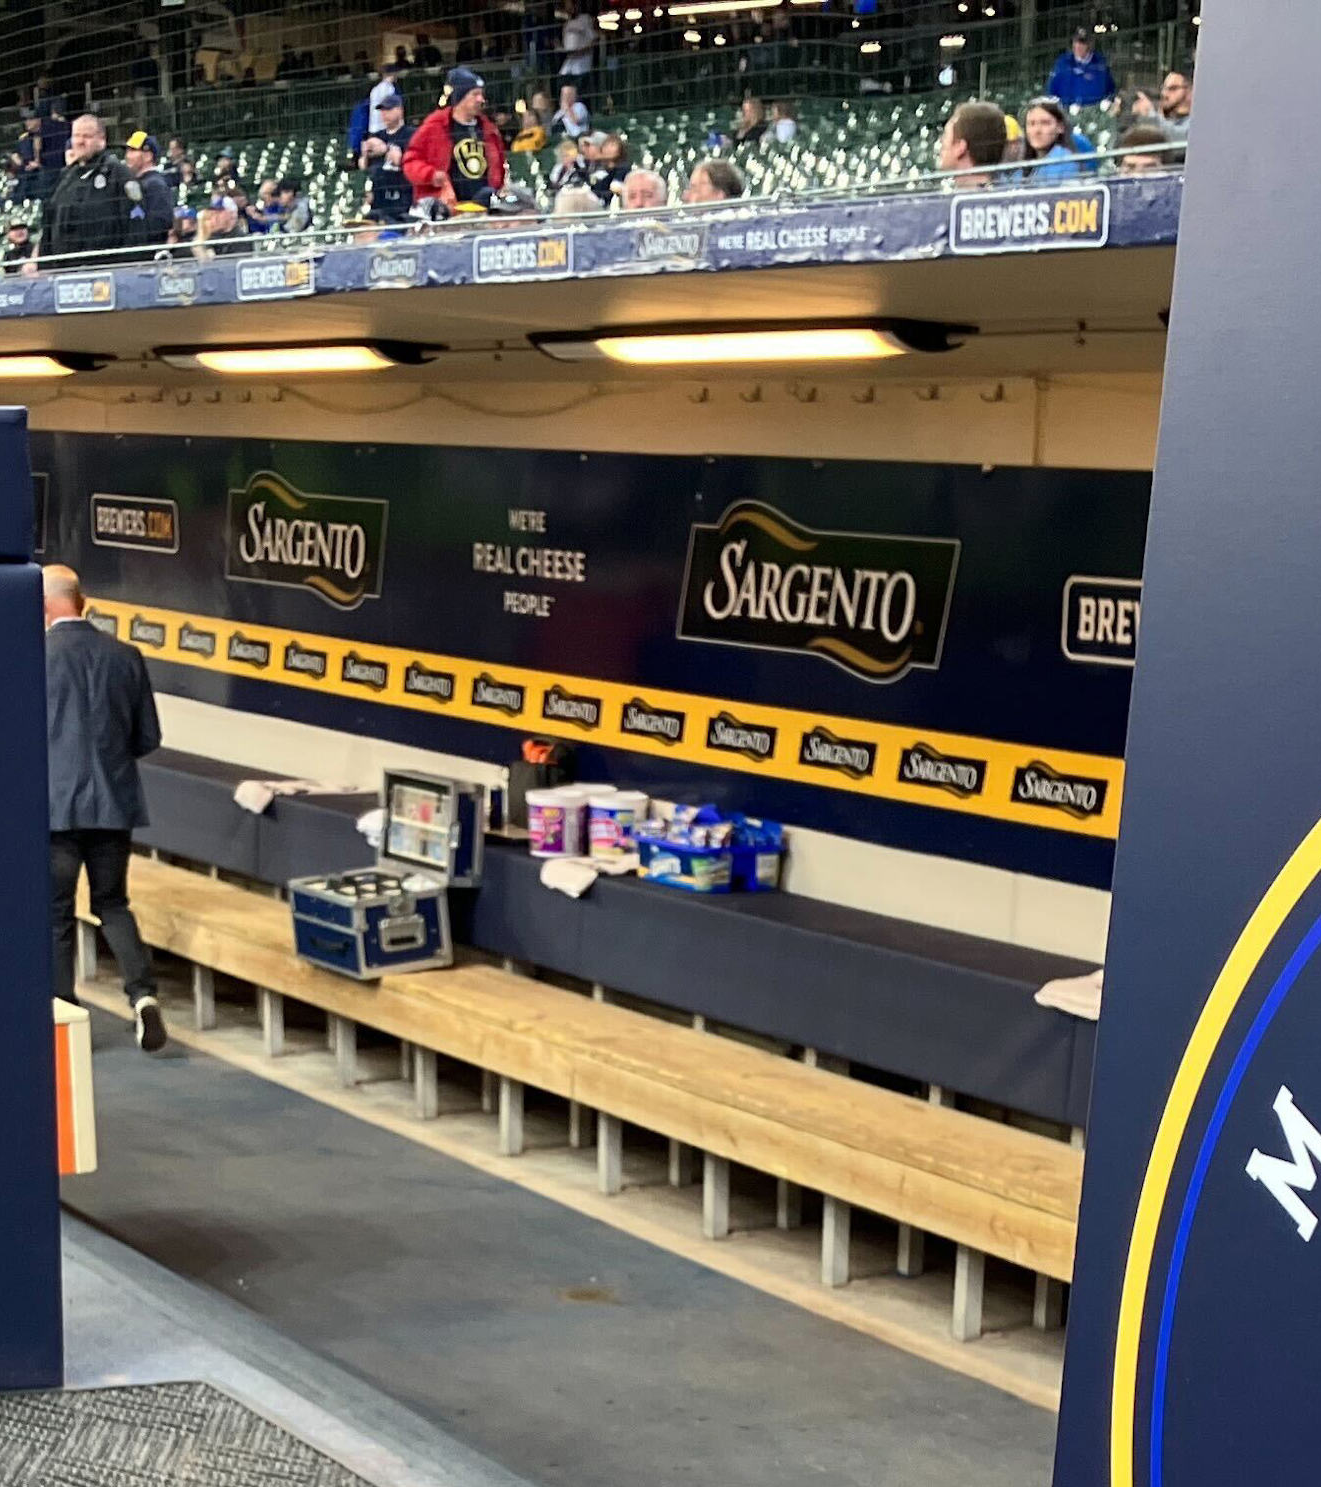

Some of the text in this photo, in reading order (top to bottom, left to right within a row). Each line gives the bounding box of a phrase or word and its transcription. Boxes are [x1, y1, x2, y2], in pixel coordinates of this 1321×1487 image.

[746, 230, 776, 250] REAL
[778, 226, 828, 248] CHEESE
[959, 199, 1099, 241] BREWERS.COM
[479, 239, 567, 272] BREWERS.COM
[96, 505, 173, 540] BREWERS.COM
[239, 502, 366, 579] SARGENTO
[473, 543, 587, 582] REAL CHEESE
[703, 539, 916, 642] SARGENTO
[1077, 596, 1140, 645] BRE
[803, 737, 870, 771] SARGENTO
[903, 752, 977, 790] SARGENTO
[1018, 771, 1097, 811] SARGENTO
